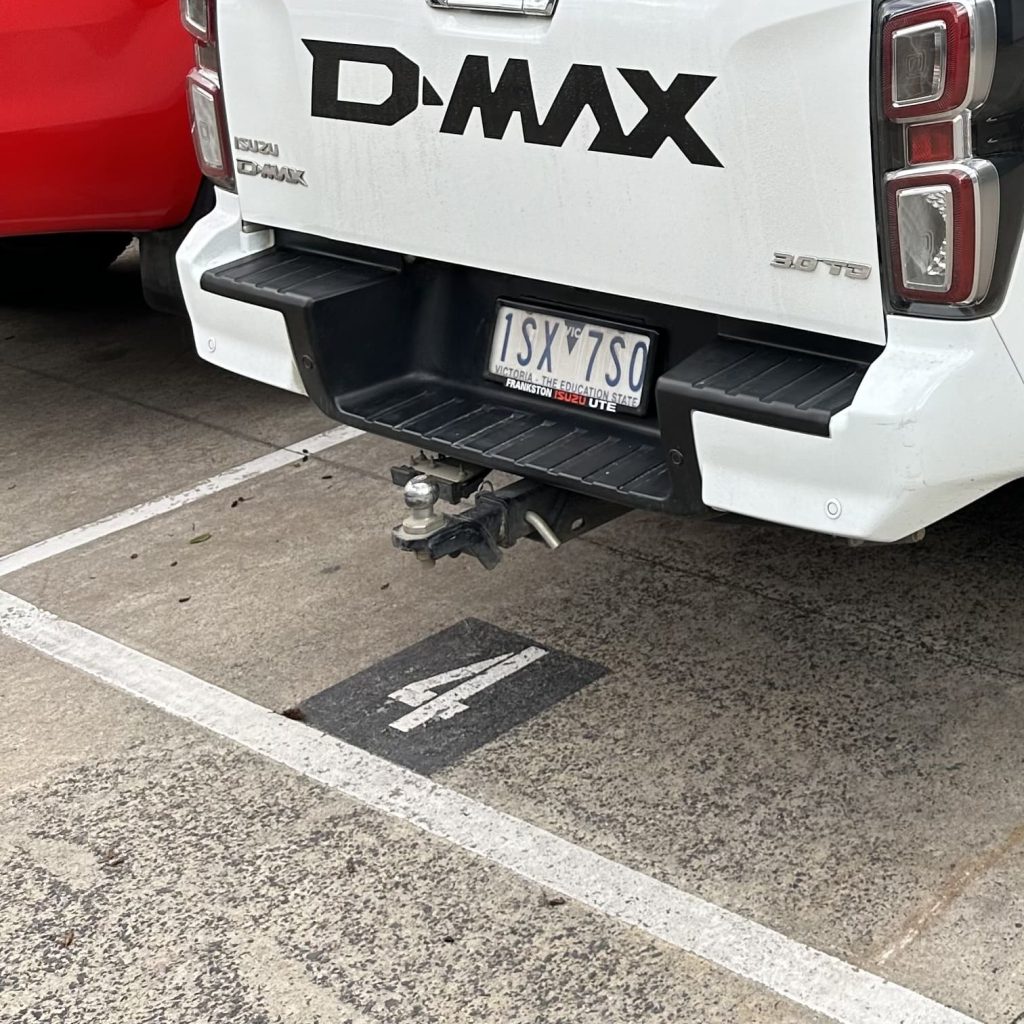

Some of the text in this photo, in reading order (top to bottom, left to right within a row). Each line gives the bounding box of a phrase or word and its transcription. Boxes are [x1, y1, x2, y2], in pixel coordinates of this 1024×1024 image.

[301, 38, 724, 169] D-MAX
[234, 136, 280, 157] ISUZU
[236, 159, 309, 187] D-MAX
[769, 252, 818, 273] 3.0
[500, 313, 560, 372] 1SX
[565, 326, 582, 339] VIC
[495, 365, 533, 382] VICTORIA
[542, 376, 559, 388] THE
[560, 380, 610, 402] EDUCATION
[611, 391, 638, 407] STATE
[506, 378, 617, 413] FRANKSTON ISUZU UTE
[388, 645, 549, 734] 4
